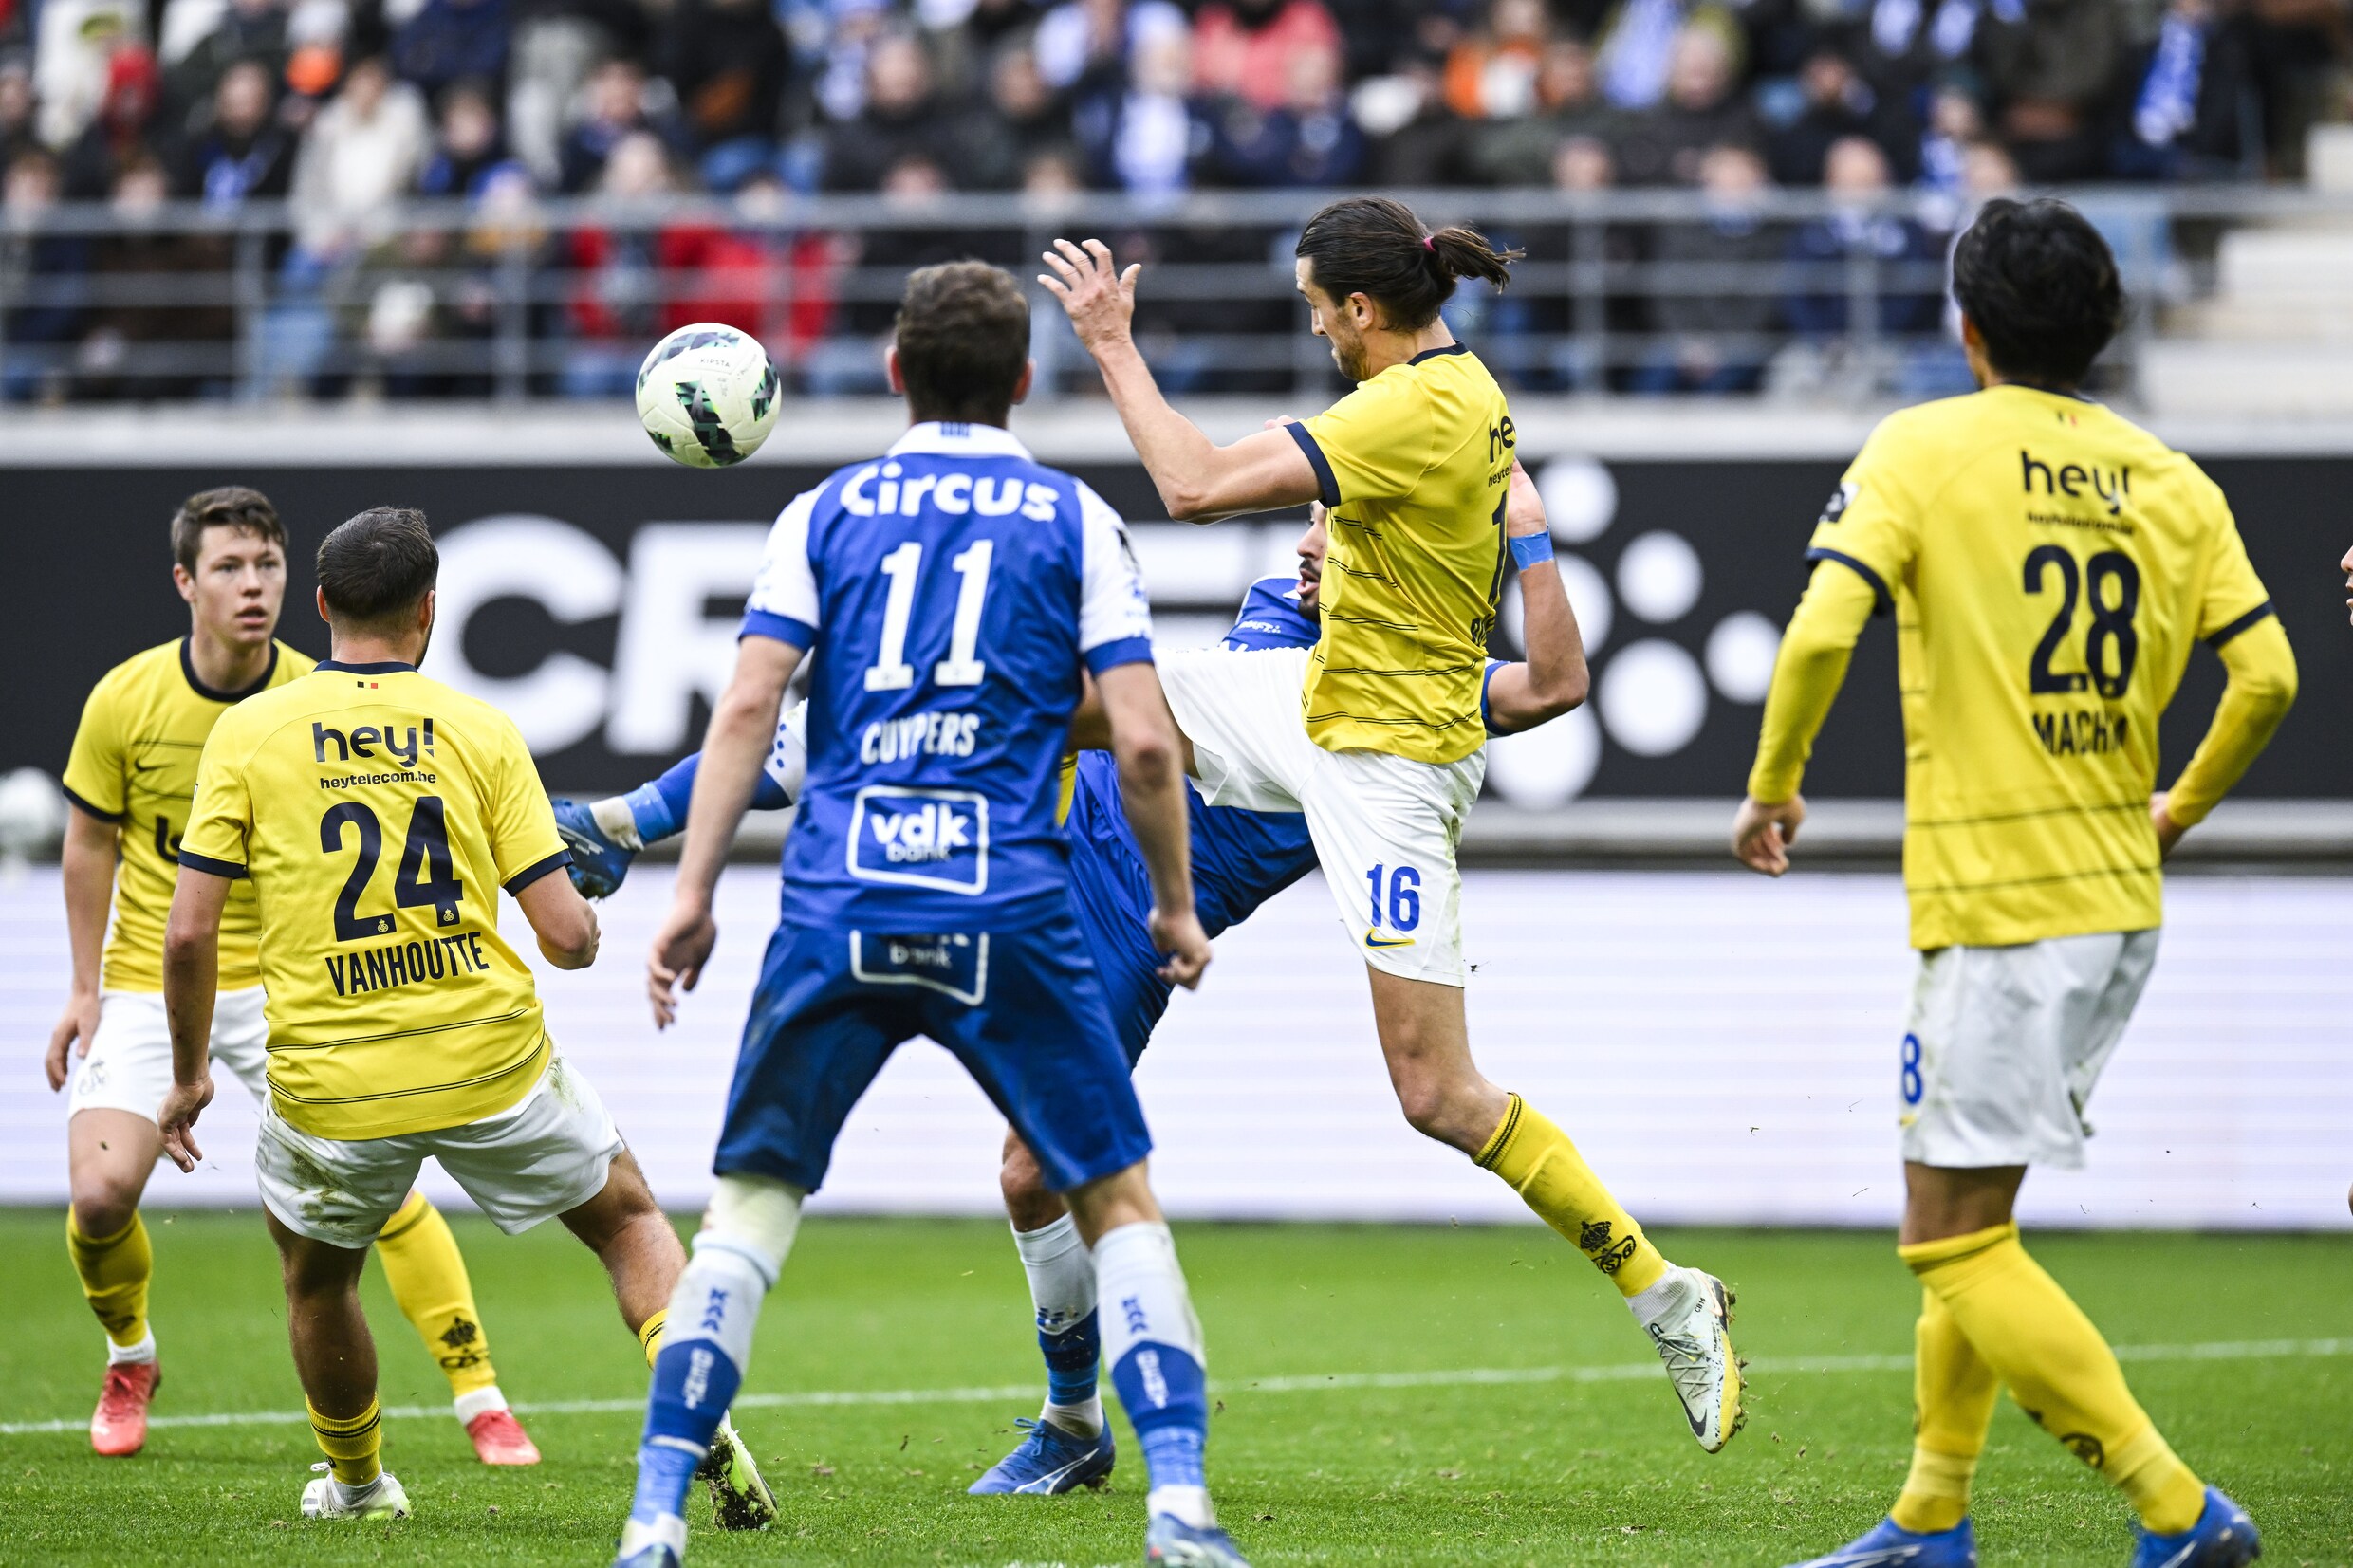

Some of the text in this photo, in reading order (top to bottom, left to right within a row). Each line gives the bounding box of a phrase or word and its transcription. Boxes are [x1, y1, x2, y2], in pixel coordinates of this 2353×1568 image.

[700, 358, 730, 368] KIPSTA
[1489, 415, 1516, 464] he
[840, 461, 1060, 523] Circus
[2020, 449, 2131, 516] hey!
[863, 538, 994, 692] 11
[2024, 543, 2140, 699] 28
[311, 717, 435, 768] hey!
[860, 711, 980, 765] CUYPERS
[320, 770, 436, 790] heytelecom.be
[869, 802, 970, 847] vdk
[320, 795, 464, 943] 24
[1366, 863, 1421, 932] 16
[324, 931, 491, 997] VANHOUTTE
[1902, 1032, 1923, 1106] 8
